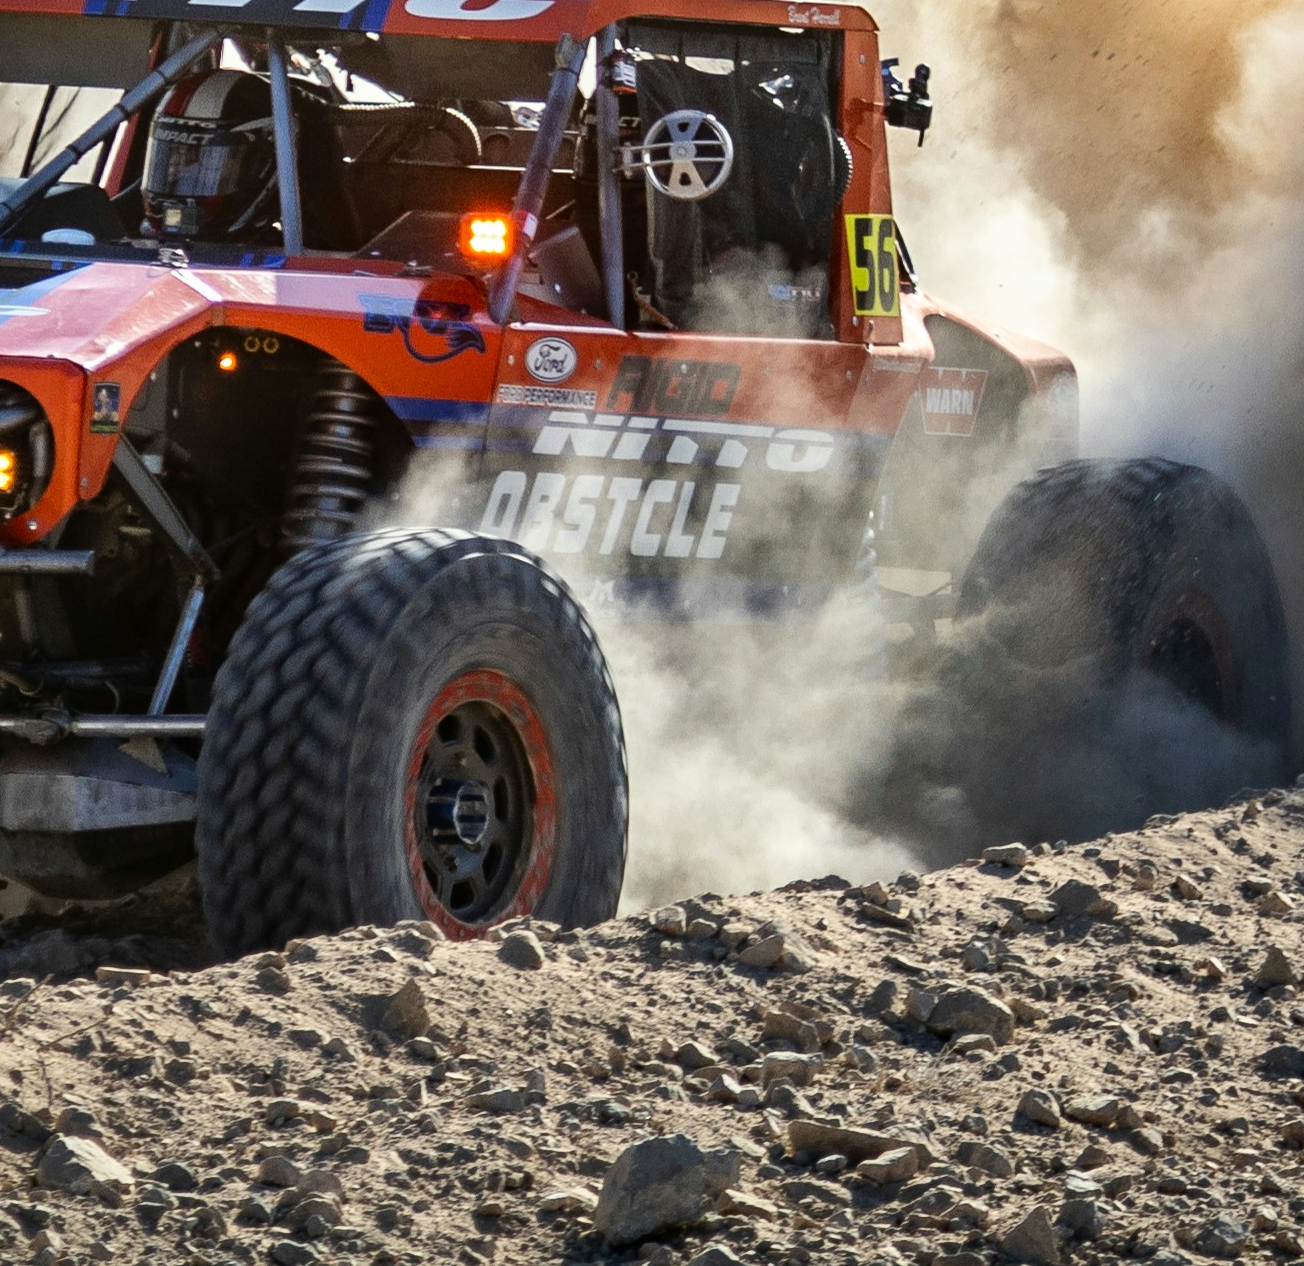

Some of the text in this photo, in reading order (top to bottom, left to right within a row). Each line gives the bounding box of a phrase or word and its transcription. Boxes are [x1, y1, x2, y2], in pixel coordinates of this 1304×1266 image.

[854, 218, 895, 312] 56
[534, 343, 569, 373] Ford
[926, 386, 974, 415] WARN
[532, 411, 835, 473] NITTO
